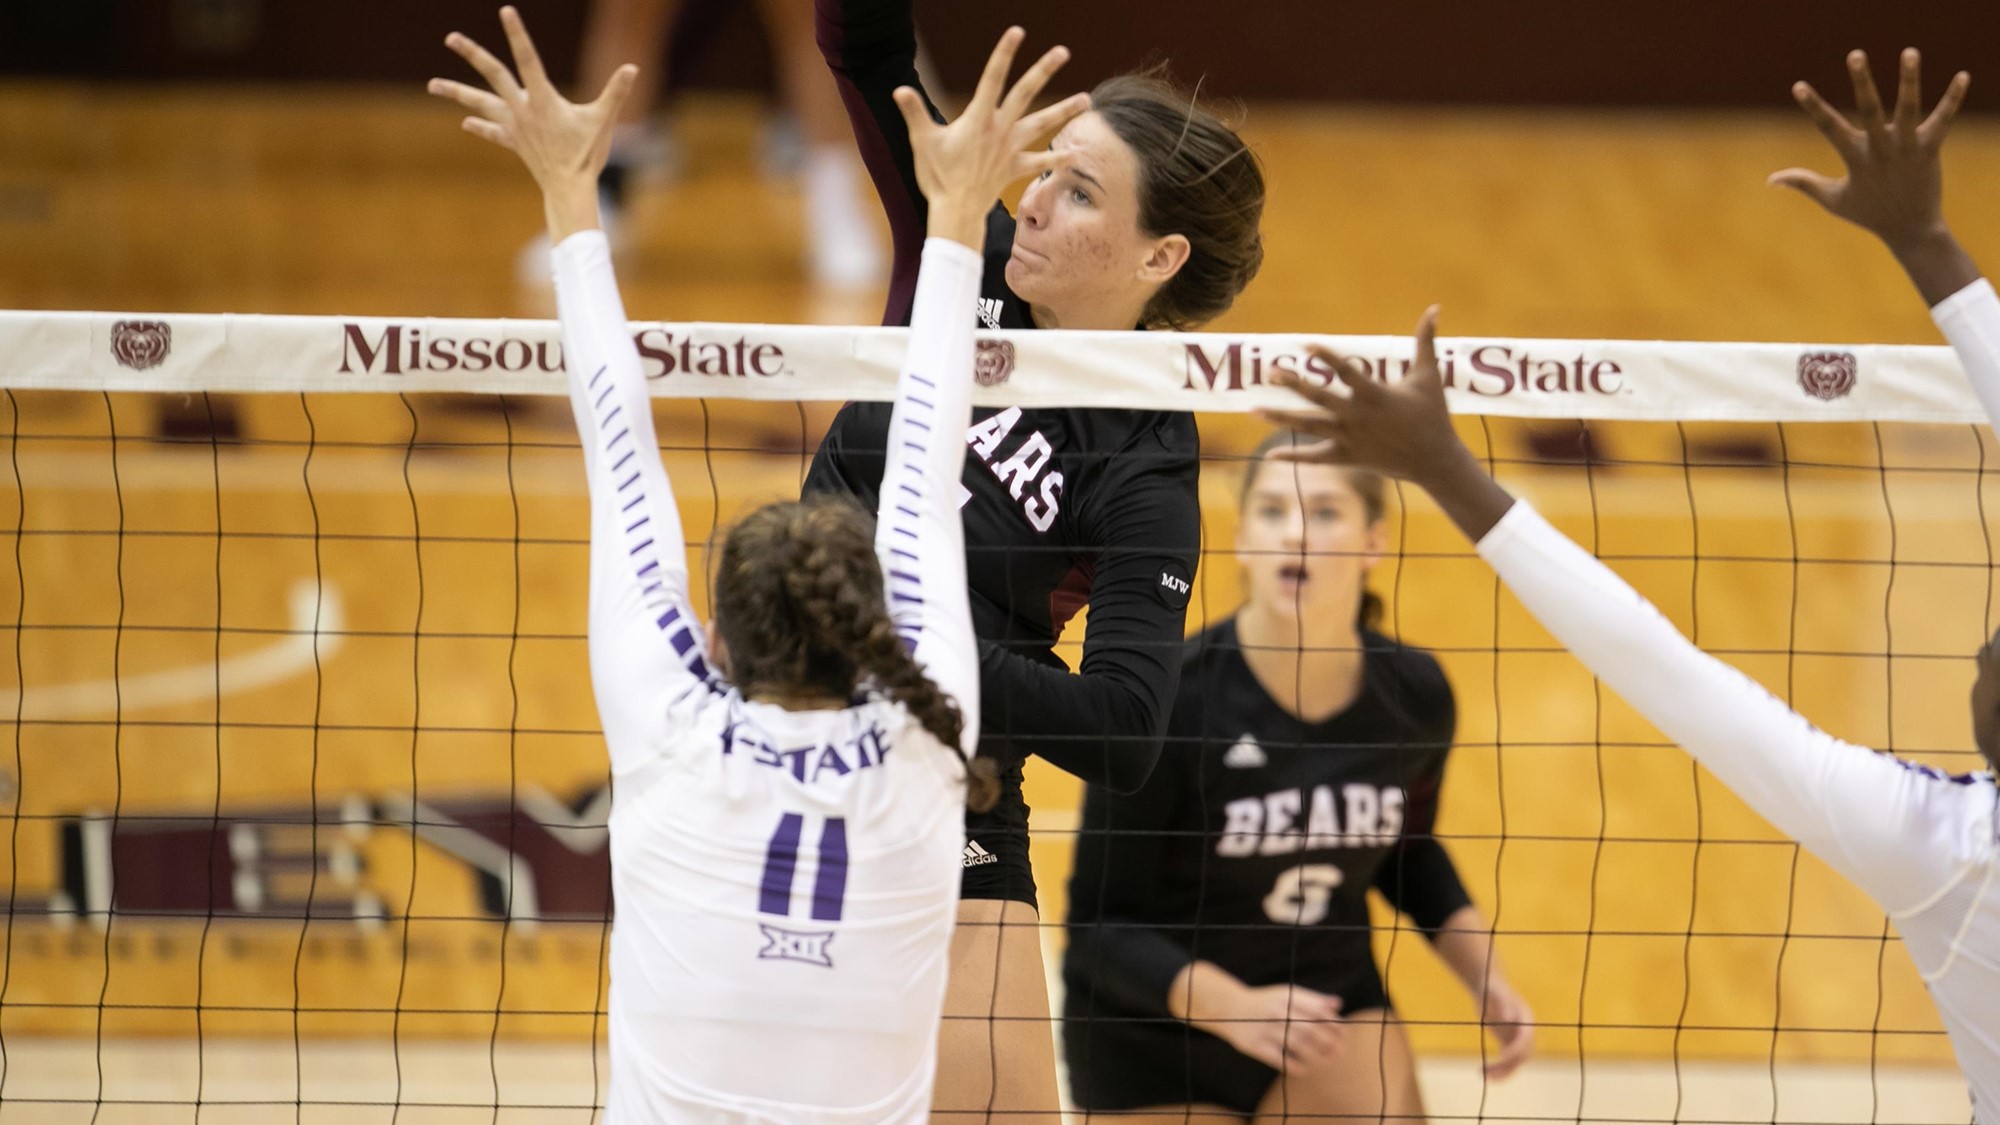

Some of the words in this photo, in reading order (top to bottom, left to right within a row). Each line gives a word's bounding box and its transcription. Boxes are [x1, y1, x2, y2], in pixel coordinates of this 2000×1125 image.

[338, 323, 567, 374] Missou
[633, 328, 784, 379] State
[1469, 346, 1623, 396] State
[966, 405, 1064, 533] ARS
[1161, 572, 1190, 595] MJW
[1215, 783, 1405, 858] BEARS
[758, 812, 848, 921] 11
[960, 853, 998, 868] didas
[1262, 864, 1344, 925] 6
